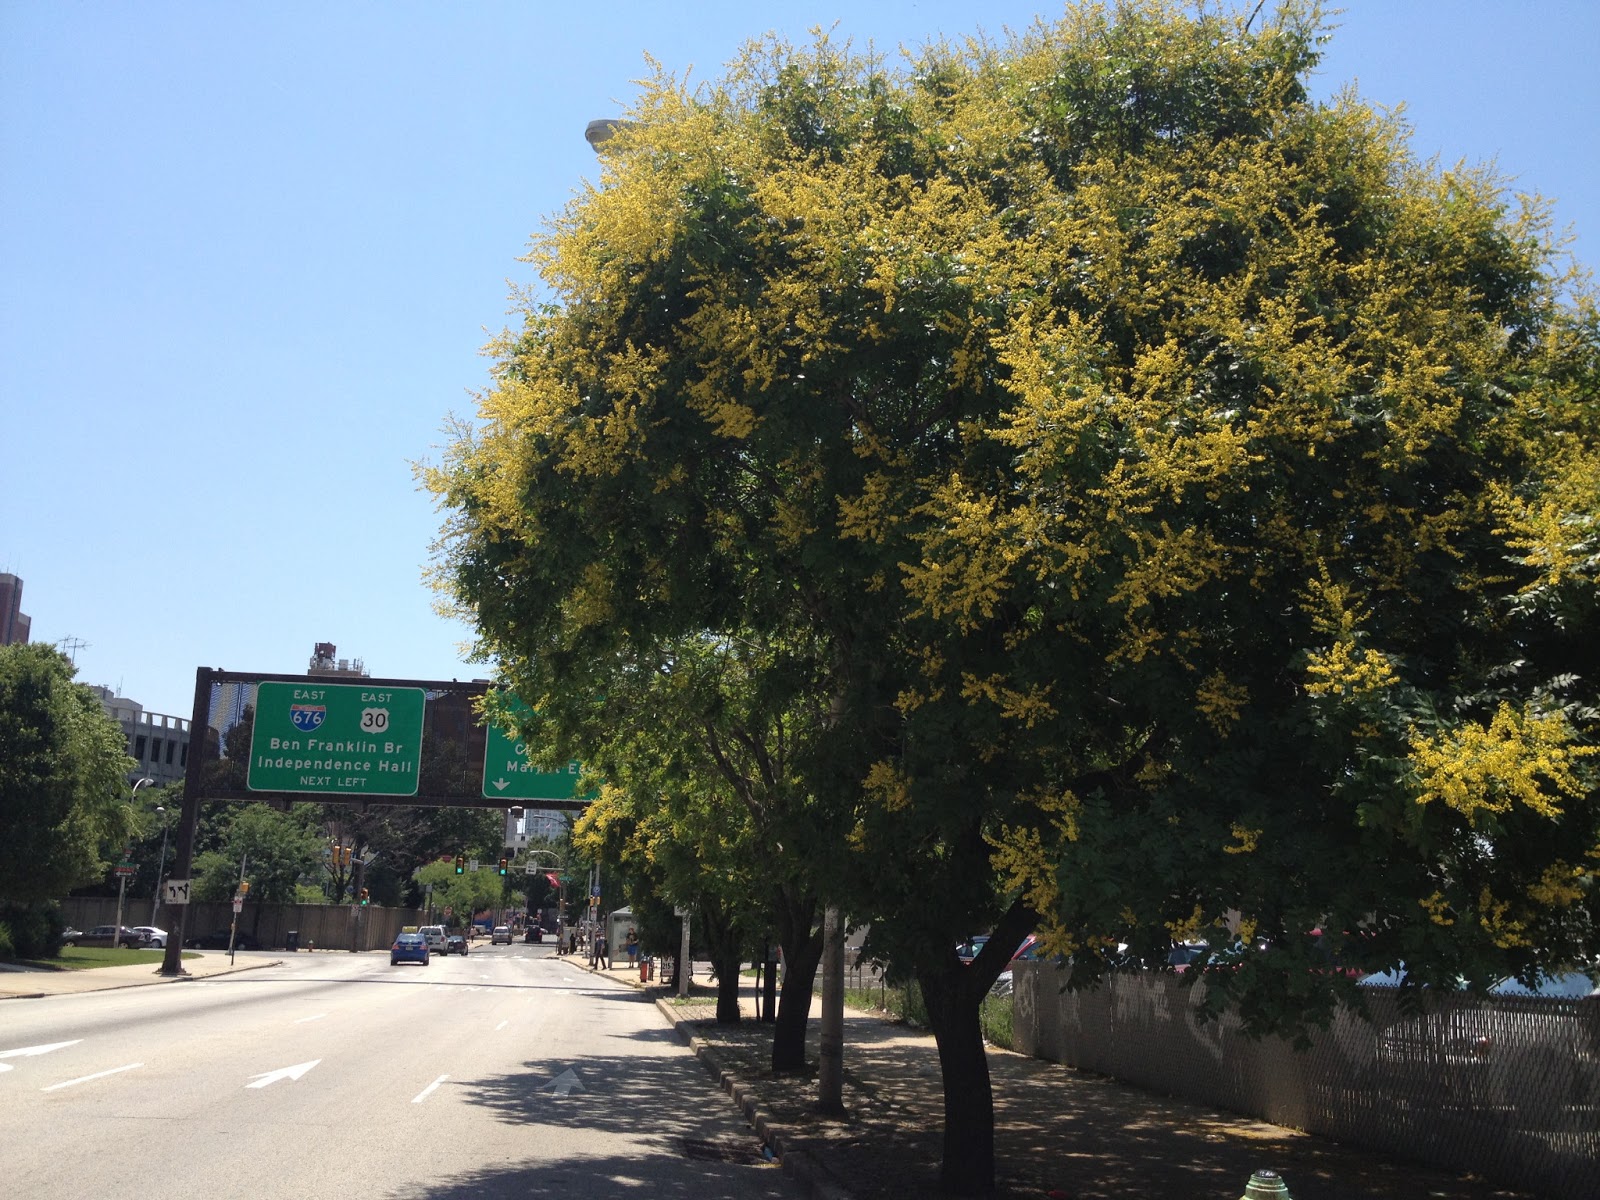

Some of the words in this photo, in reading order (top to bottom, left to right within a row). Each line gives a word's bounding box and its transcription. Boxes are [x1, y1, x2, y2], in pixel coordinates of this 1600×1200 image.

[293, 690, 326, 700] EAST
[361, 693, 393, 703] EAST
[293, 711, 322, 725] 676
[363, 713, 386, 728] 30
[270, 738, 300, 750] Ben
[308, 739, 377, 753] Franklin
[384, 742, 403, 754] Br
[258, 756, 371, 771] Independence
[378, 760, 411, 773] Hall
[300, 776, 331, 786] NEXT
[337, 777, 367, 787] LEFT
